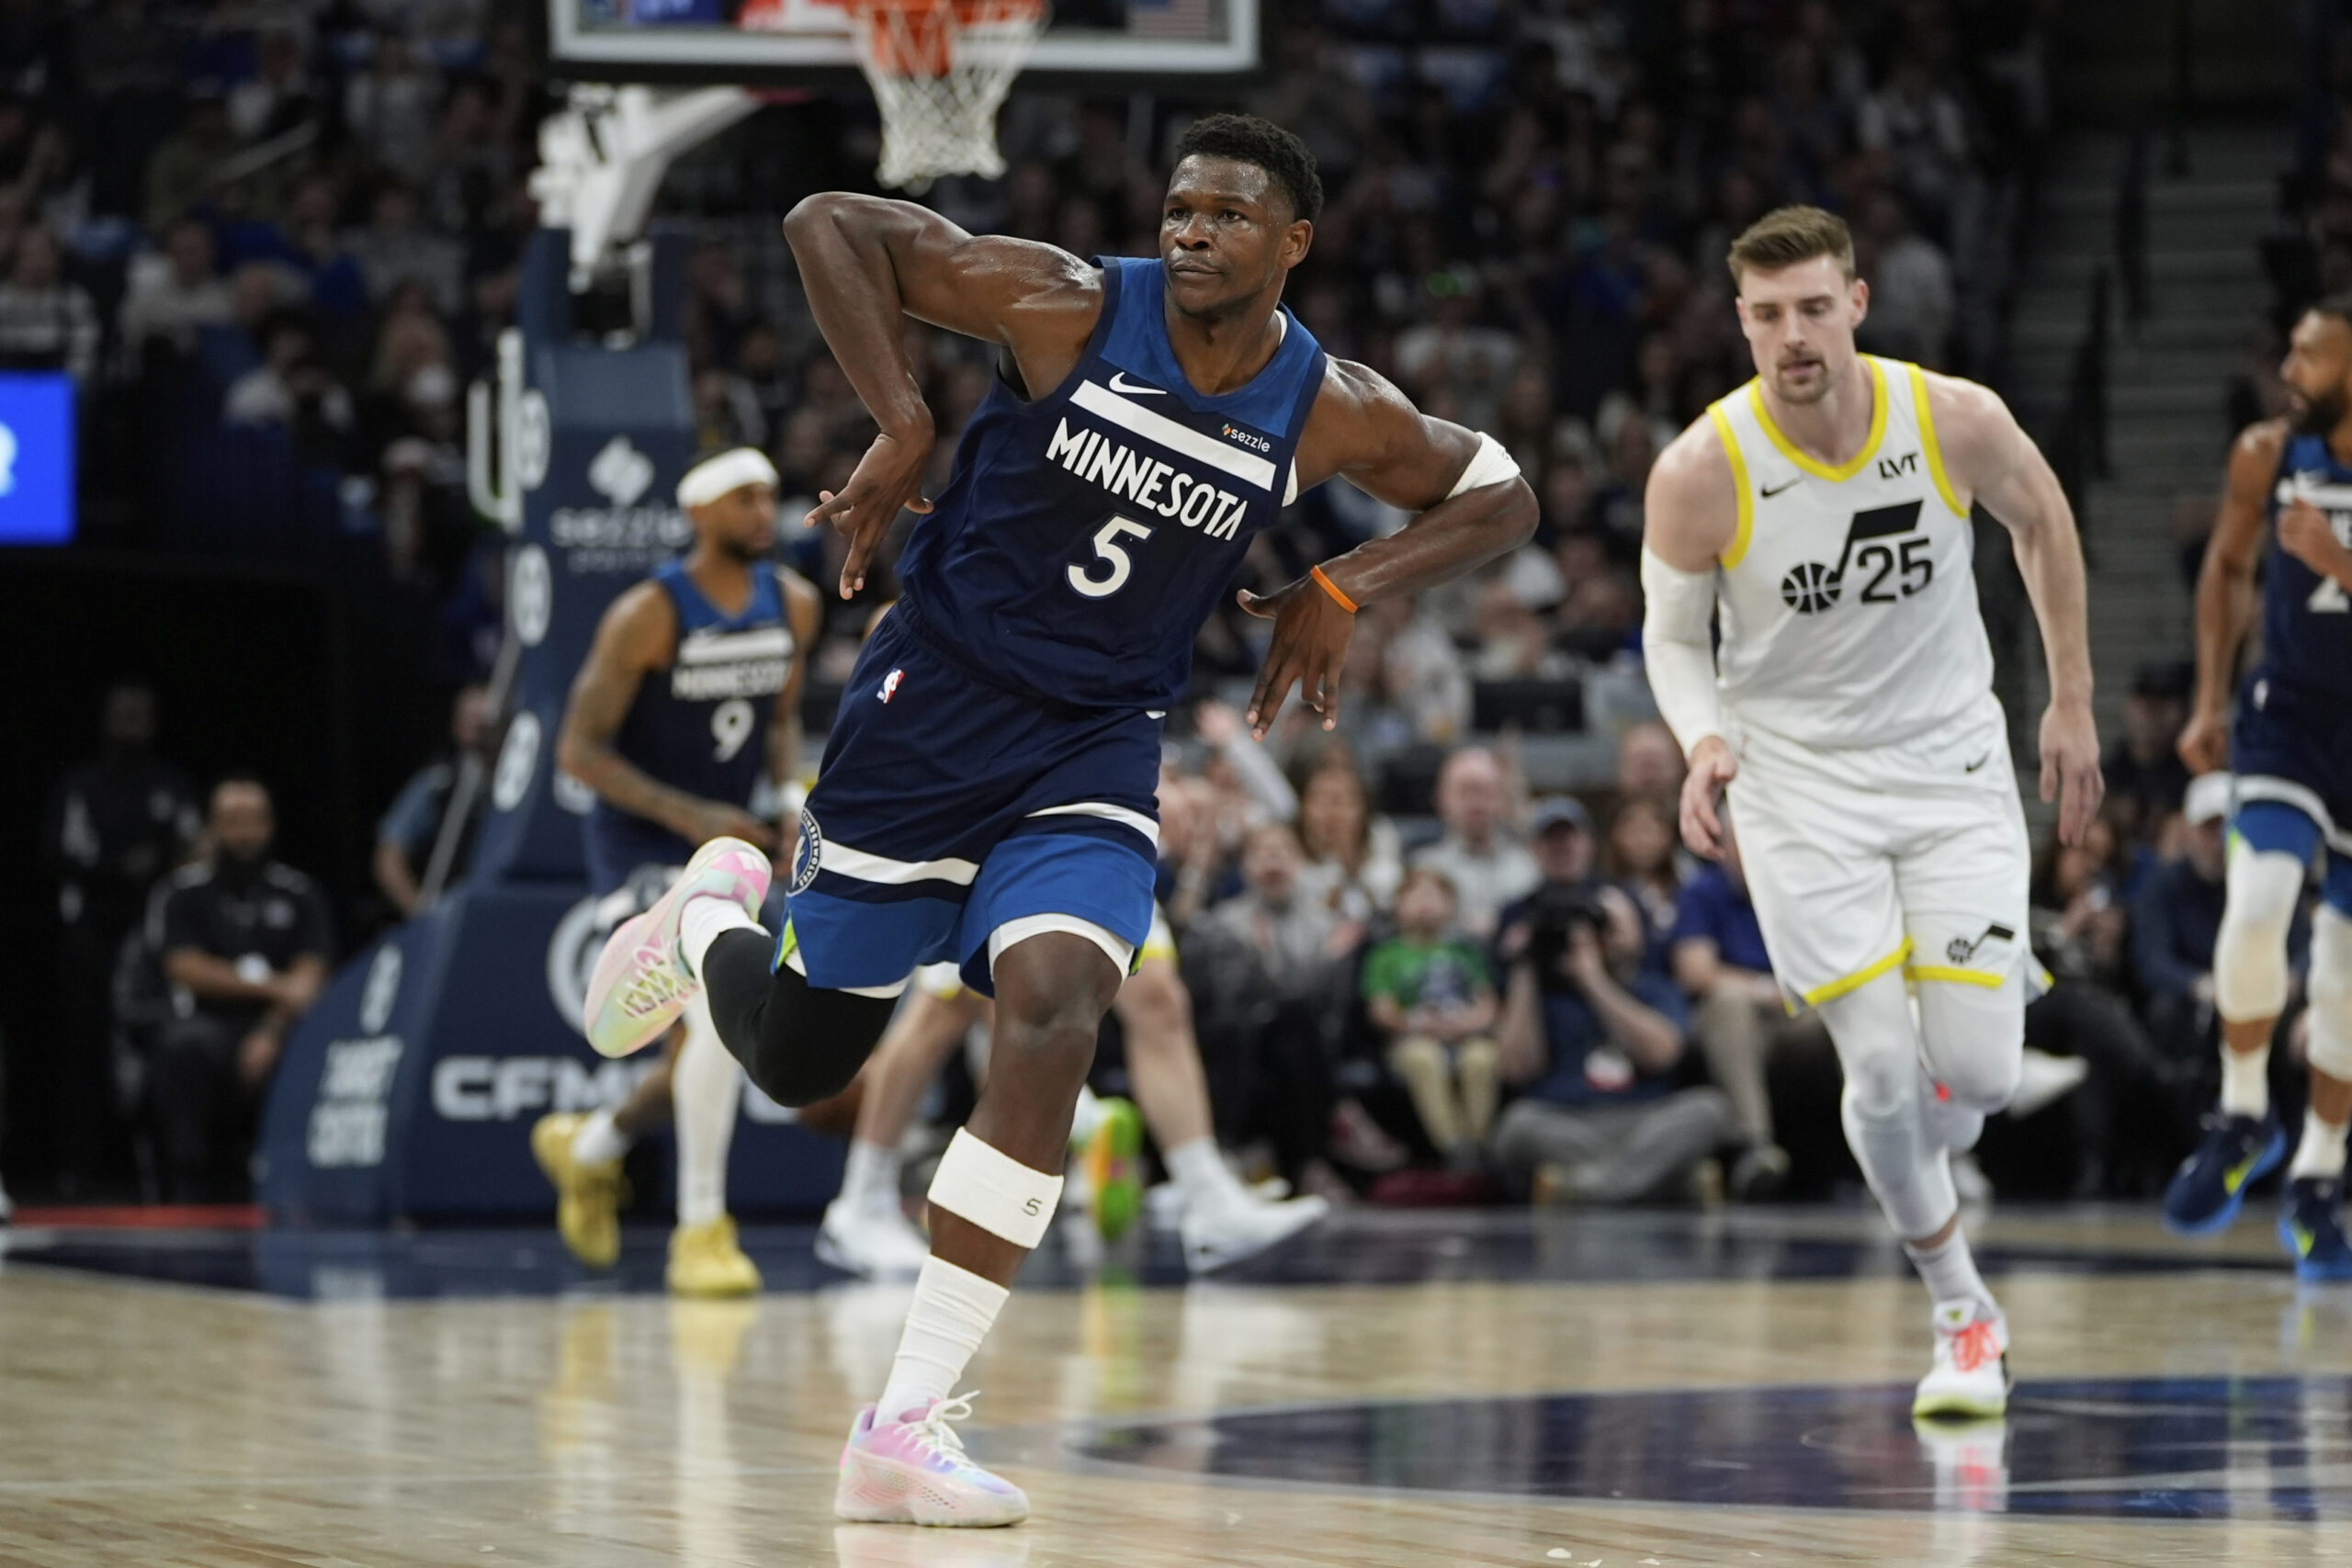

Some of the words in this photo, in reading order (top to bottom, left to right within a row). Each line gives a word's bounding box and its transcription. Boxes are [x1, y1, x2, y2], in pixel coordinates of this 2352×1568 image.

[1230, 428, 1271, 453] sezzle
[1879, 453, 1918, 479] LVT
[1046, 416, 1249, 541] MINNESOTA
[1067, 514, 1153, 597] 5
[1857, 537, 1933, 605] 25
[710, 699, 754, 762] 9
